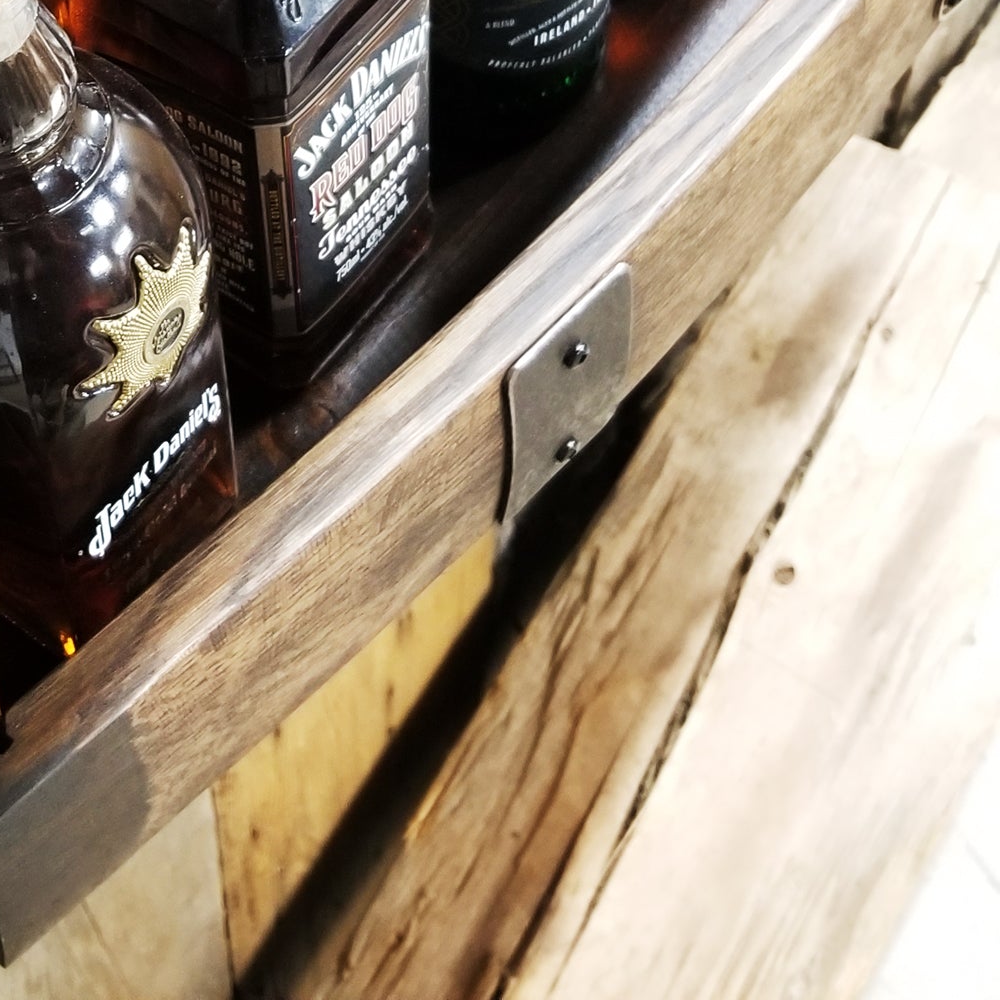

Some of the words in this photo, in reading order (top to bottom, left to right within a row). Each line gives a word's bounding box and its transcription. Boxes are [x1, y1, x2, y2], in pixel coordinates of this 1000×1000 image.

[533, 8, 585, 47] IRELAND
[186, 113, 244, 155] SALOON
[292, 92, 354, 180] JACK
[308, 133, 369, 224] RED
[370, 71, 420, 153] DOG
[322, 118, 415, 231] SALOON
[318, 145, 416, 260] Tennessee
[333, 176, 409, 267] WHISKEY
[88, 460, 152, 558] Jack
[152, 383, 222, 475] Daniel's
